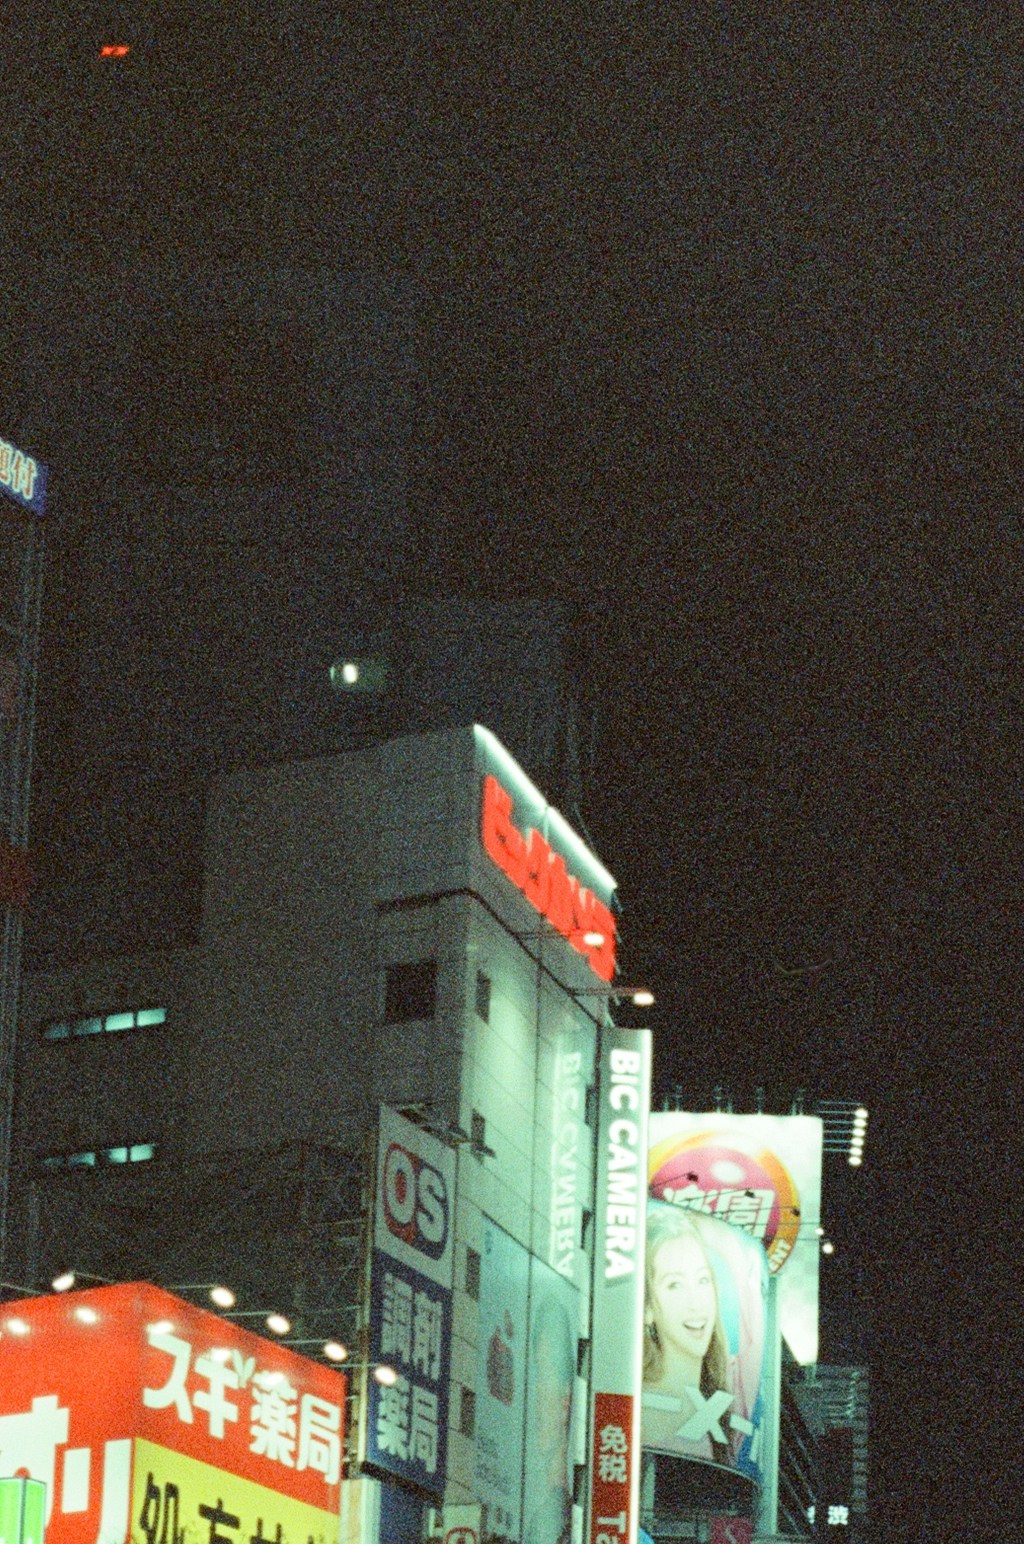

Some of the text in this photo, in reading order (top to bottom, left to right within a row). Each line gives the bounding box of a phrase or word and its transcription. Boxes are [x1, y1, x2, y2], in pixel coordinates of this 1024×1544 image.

[382, 1143, 448, 1259] OS
[605, 1049, 641, 1279] BIC CAMERA
[143, 1326, 342, 1485] スギ薬局
[376, 1368, 438, 1474] 薬局
[599, 1424, 627, 1484] 免税
